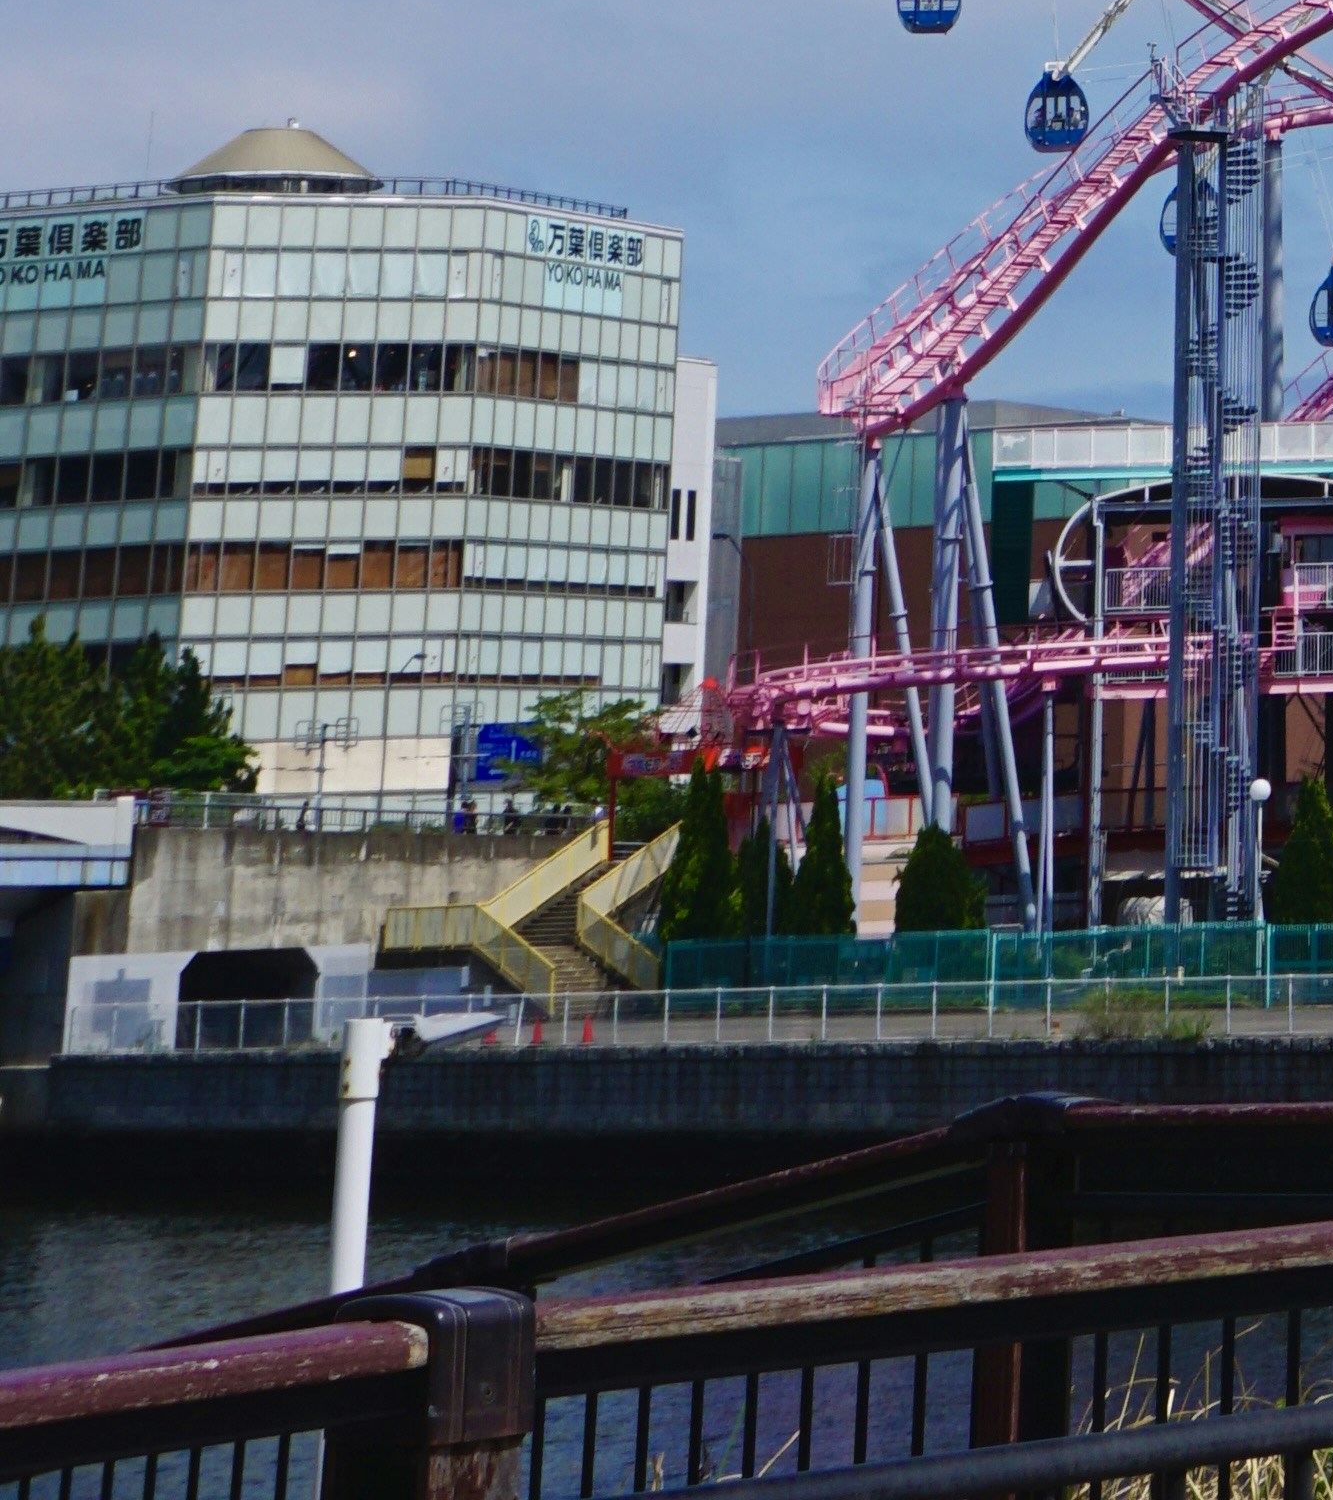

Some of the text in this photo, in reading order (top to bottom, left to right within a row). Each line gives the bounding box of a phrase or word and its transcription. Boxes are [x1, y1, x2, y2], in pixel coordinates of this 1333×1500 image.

[548, 223, 643, 267] 万葉倶楽部
[547, 262, 621, 292] YOKOHAMA
